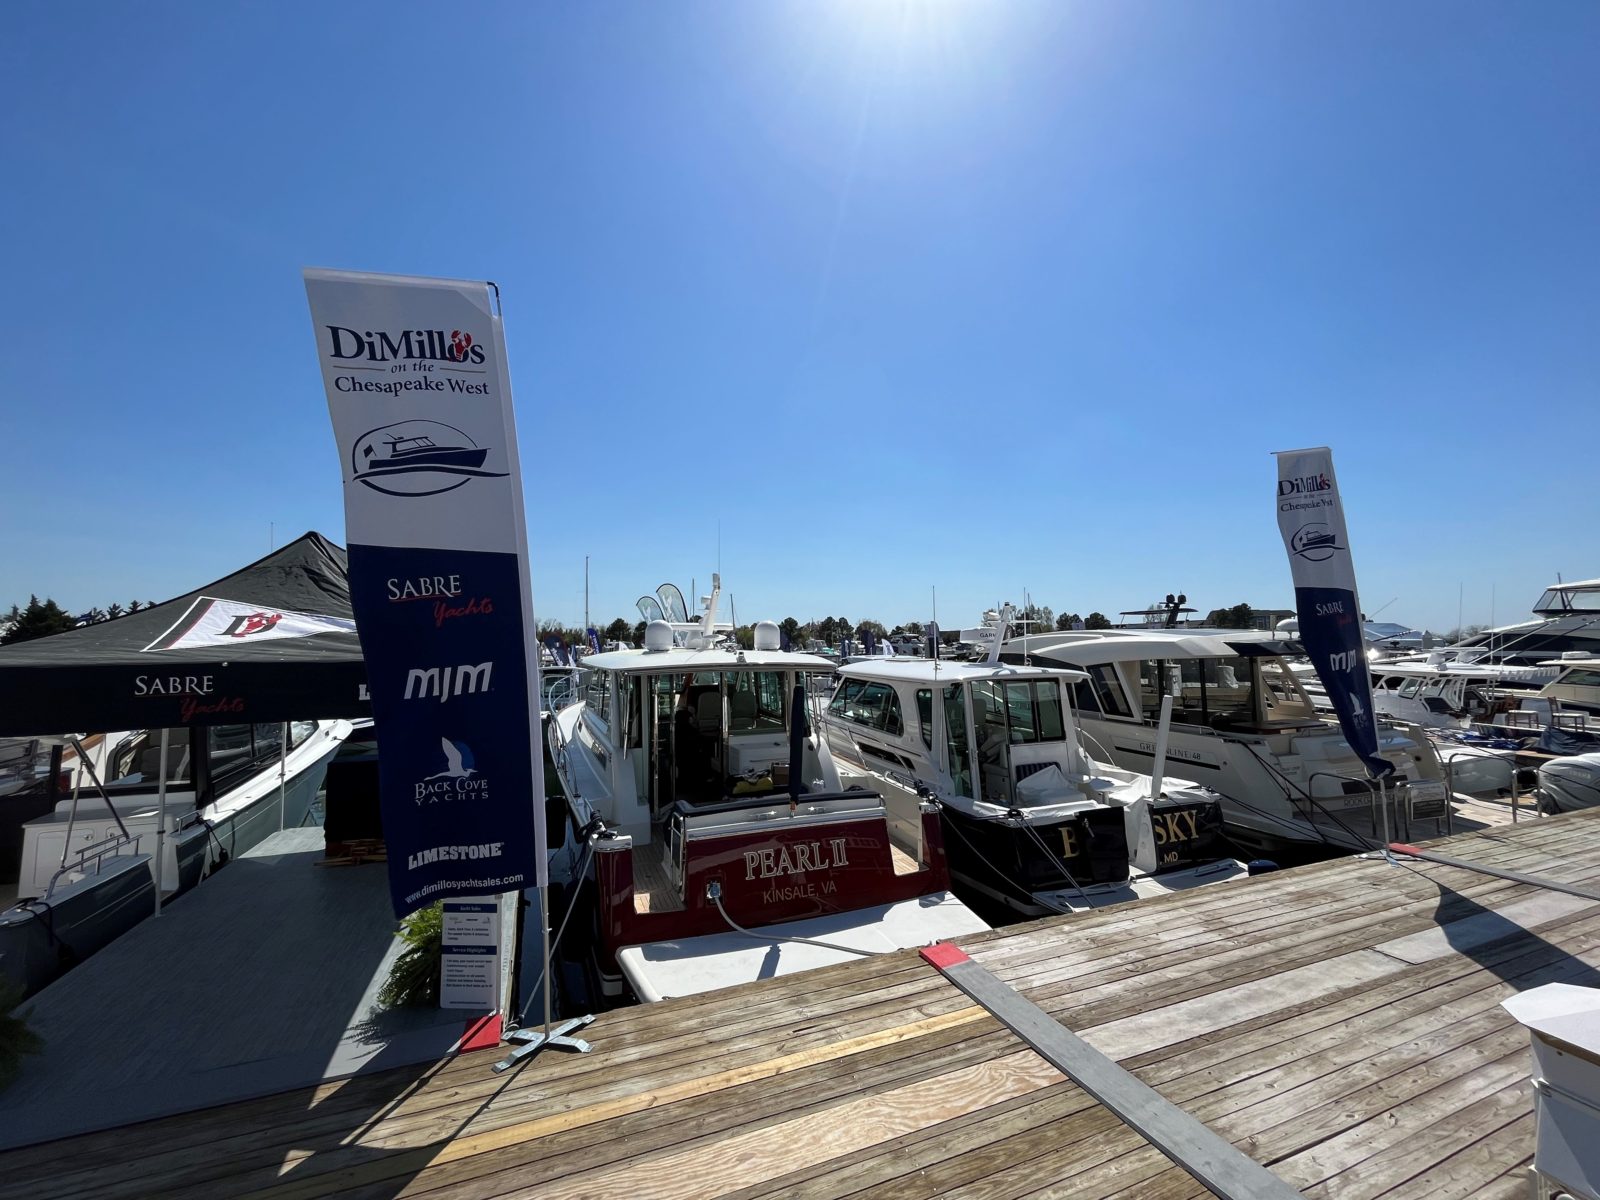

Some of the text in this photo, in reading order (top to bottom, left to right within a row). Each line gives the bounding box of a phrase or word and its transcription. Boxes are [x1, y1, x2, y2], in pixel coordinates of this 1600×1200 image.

[391, 359, 434, 374] on the
[334, 376, 490, 397] Chesapeake West
[387, 575, 462, 600] SABRE
[433, 598, 494, 627] Yachts
[1316, 601, 1344, 616] SABRE
[135, 675, 214, 696] SABRE
[180, 696, 245, 722] Yachts
[1139, 742, 1188, 759] GRENLINE
[414, 777, 488, 800] BACK COVE
[415, 791, 489, 806] YACHTS
[408, 842, 502, 870] LIMESTONE
[744, 838, 849, 881] PEARL II
[1164, 851, 1178, 863] MD
[405, 874, 524, 904] www.dimillosyachtsales.com
[763, 880, 837, 904] KINSALE, VA
